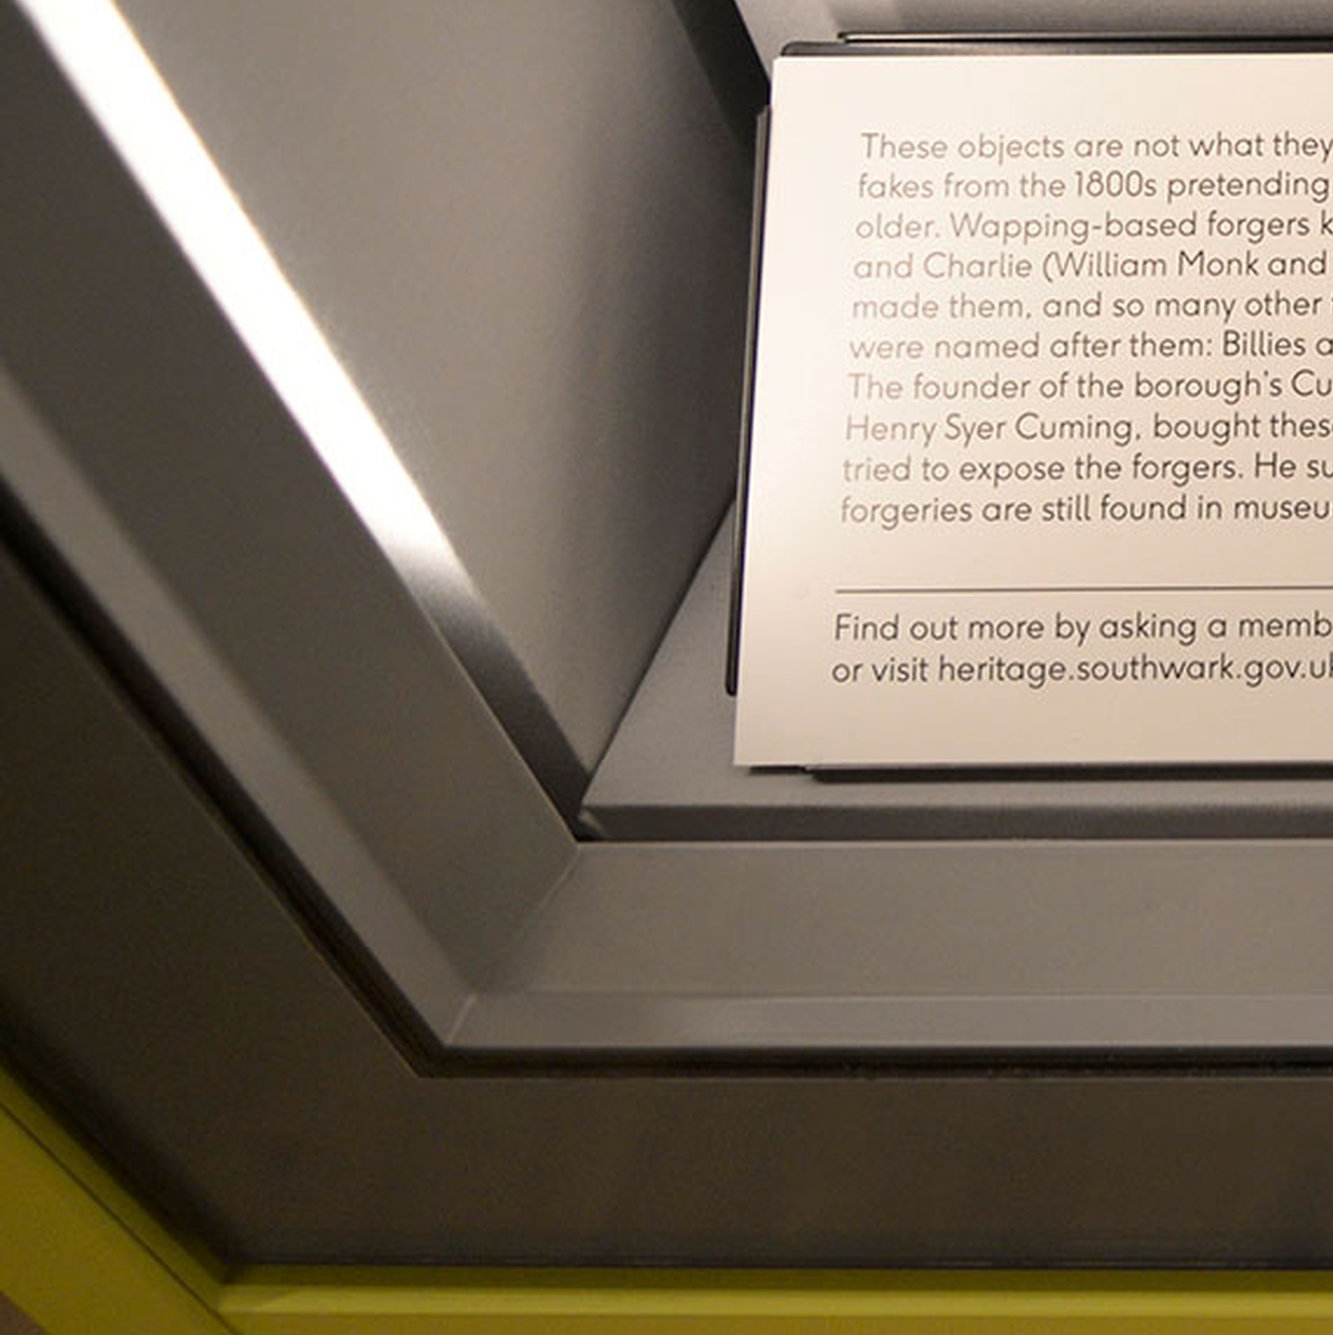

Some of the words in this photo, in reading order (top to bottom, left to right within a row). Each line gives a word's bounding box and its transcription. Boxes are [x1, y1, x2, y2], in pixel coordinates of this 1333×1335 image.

[861, 132, 948, 160] These
[957, 133, 1065, 166] objects
[1073, 139, 1124, 159] are
[1133, 134, 1181, 158] not
[1187, 130, 1266, 158] what
[858, 172, 934, 199] fakes
[944, 171, 1010, 198] from
[1019, 171, 1067, 199] the
[1074, 169, 1157, 198] 1800s
[1166, 169, 1330, 205] pretending
[949, 210, 1198, 246] Wapping-based
[1207, 209, 1311, 245] forgers
[854, 253, 913, 279] and
[923, 251, 1033, 279] Charlie
[1042, 251, 1167, 284] (William
[1177, 249, 1260, 277] Monk
[1267, 249, 1328, 277] and
[853, 292, 939, 319] made
[949, 292, 1032, 319] them,
[1042, 290, 1102, 318] and
[1112, 298, 1145, 318] so
[1155, 297, 1237, 325] many
[1244, 289, 1323, 317] other
[850, 340, 924, 359] were
[935, 331, 1040, 359] named
[1049, 330, 1122, 359] after
[1128, 330, 1213, 358] them:
[1222, 328, 1307, 358] Billies
[850, 373, 903, 399] The
[914, 372, 1032, 400] founder
[1038, 370, 1070, 400] of
[1076, 371, 1125, 399] the
[846, 415, 937, 448] Henry
[944, 412, 1007, 449] Syer
[1014, 411, 1141, 448] Cuming,
[1153, 410, 1262, 447] bought
[844, 455, 911, 482] tried
[921, 458, 950, 482] to
[958, 460, 1066, 489] expose
[1074, 452, 1123, 481] the
[1132, 451, 1244, 488] forgers.
[1254, 451, 1297, 480] He
[841, 495, 973, 531] forgeries
[981, 502, 1033, 523] are
[1041, 493, 1092, 522] still
[1100, 492, 1187, 522] found
[1197, 494, 1223, 520] in
[834, 612, 900, 642] Find
[909, 615, 959, 641] out
[968, 619, 1045, 641] more
[1055, 611, 1091, 648] by
[1098, 610, 1197, 647] asking
[1207, 618, 1227, 639] a
[831, 662, 864, 683] or
[871, 656, 929, 683] visit
